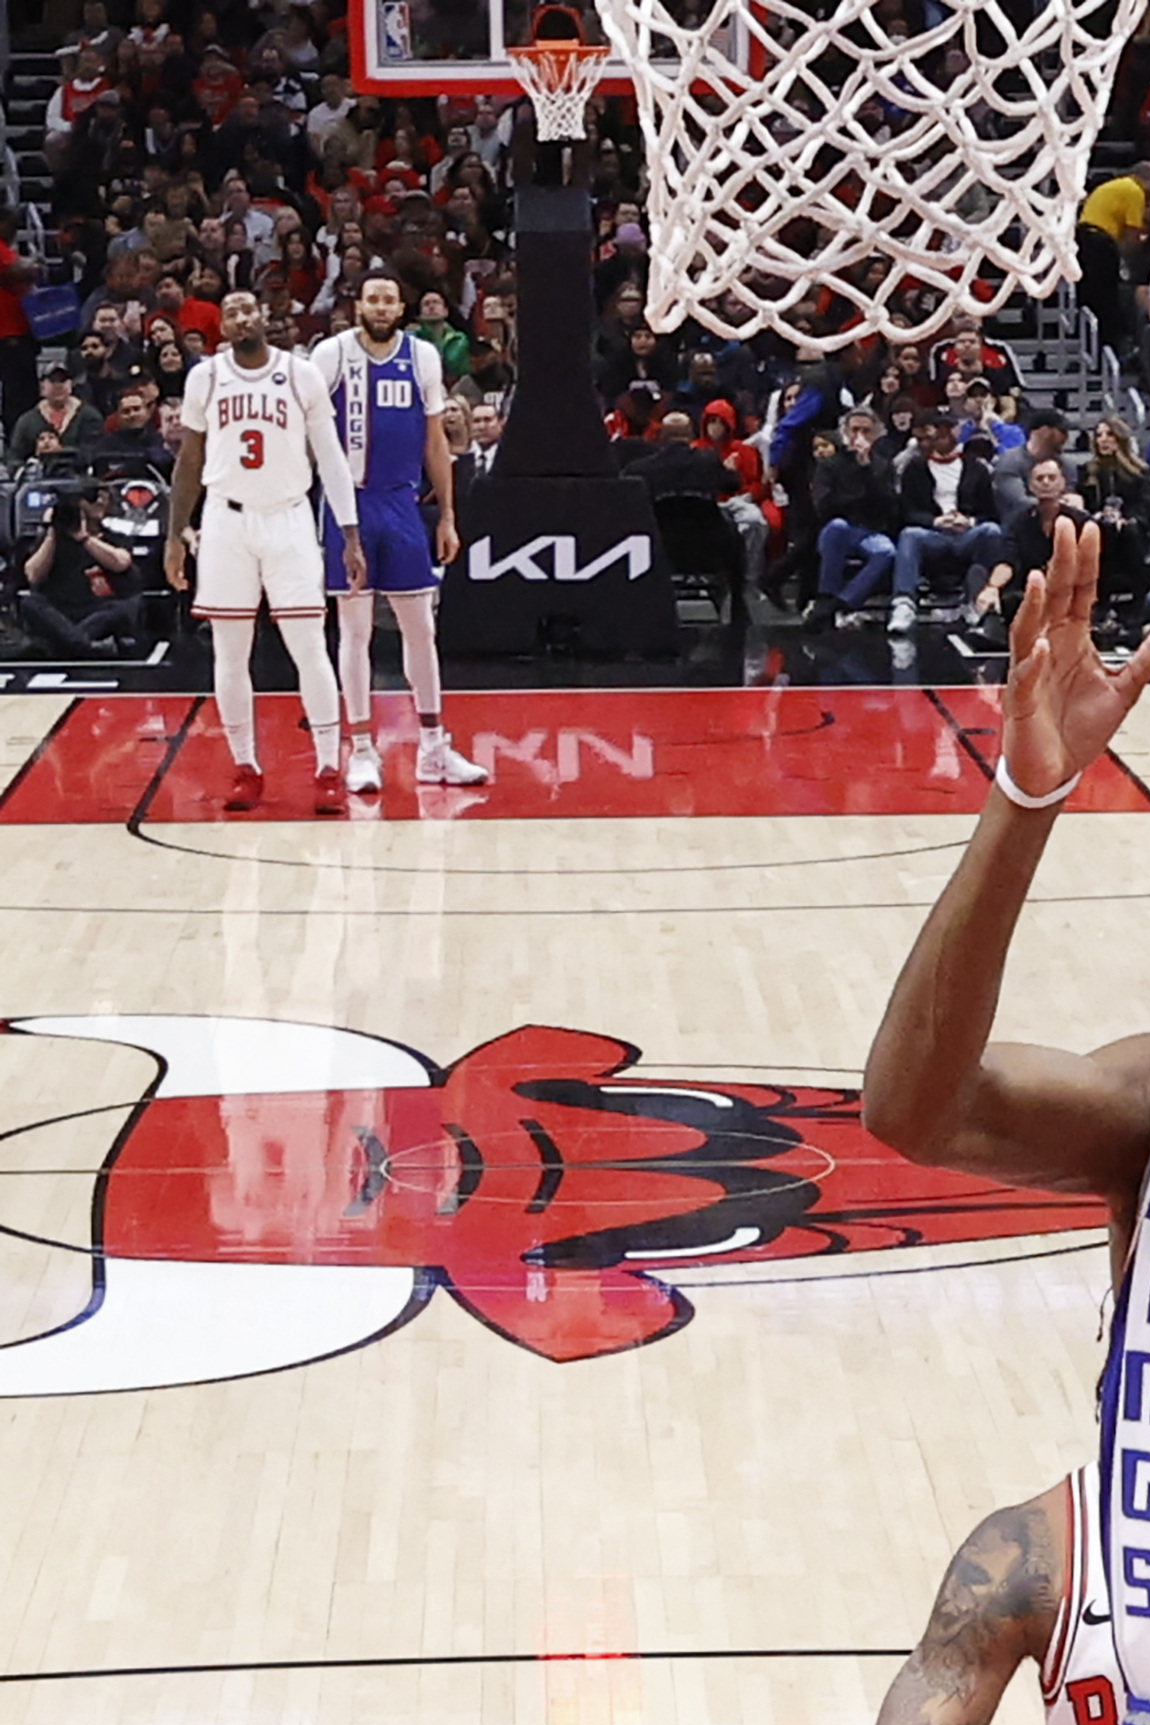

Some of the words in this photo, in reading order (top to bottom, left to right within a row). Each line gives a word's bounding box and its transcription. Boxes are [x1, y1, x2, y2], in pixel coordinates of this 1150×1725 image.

[218, 393, 288, 430] BULLS
[349, 364, 365, 451] KINGS
[376, 378, 412, 408] 00
[240, 430, 264, 470] 3
